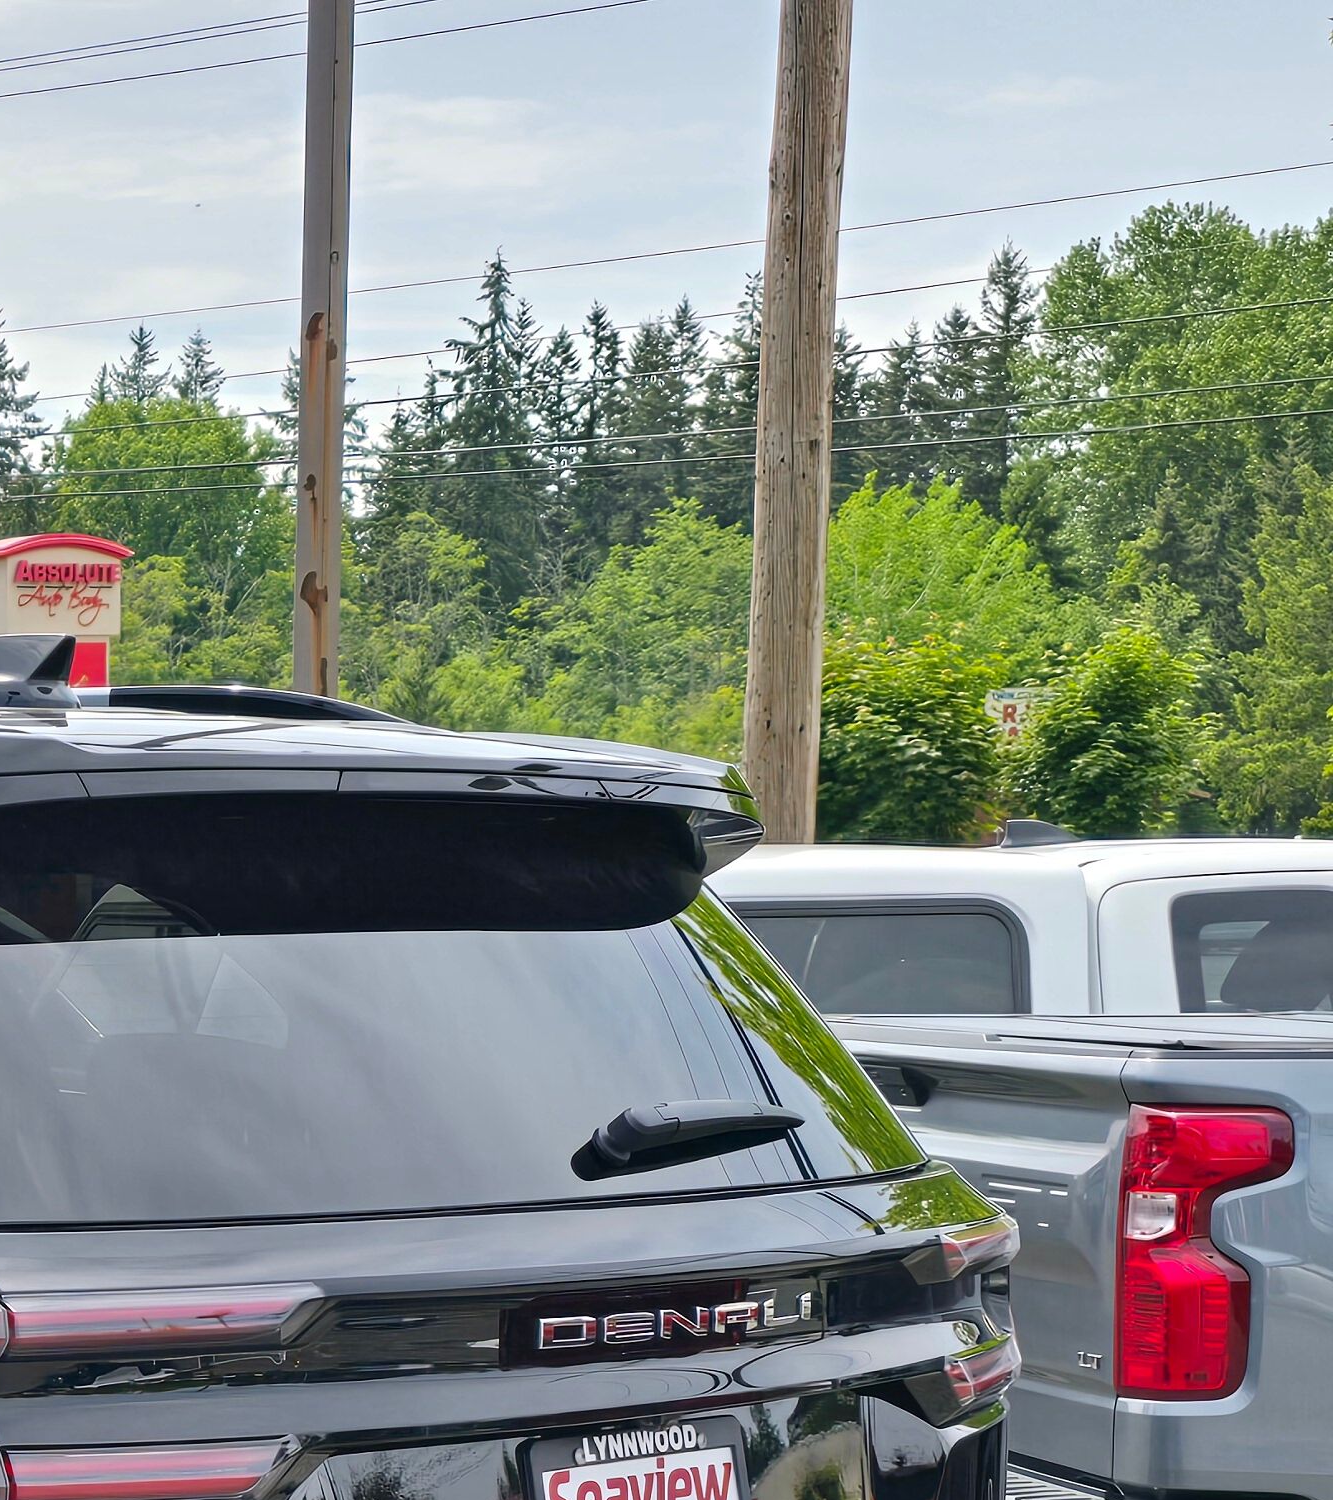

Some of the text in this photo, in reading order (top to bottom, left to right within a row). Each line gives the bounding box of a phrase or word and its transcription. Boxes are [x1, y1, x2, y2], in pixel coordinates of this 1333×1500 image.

[14, 560, 121, 583] ABSOLUTE
[538, 1289, 811, 1348] DENALI
[1077, 1351, 1103, 1370] LT
[581, 1424, 697, 1462] LYNNWOOD
